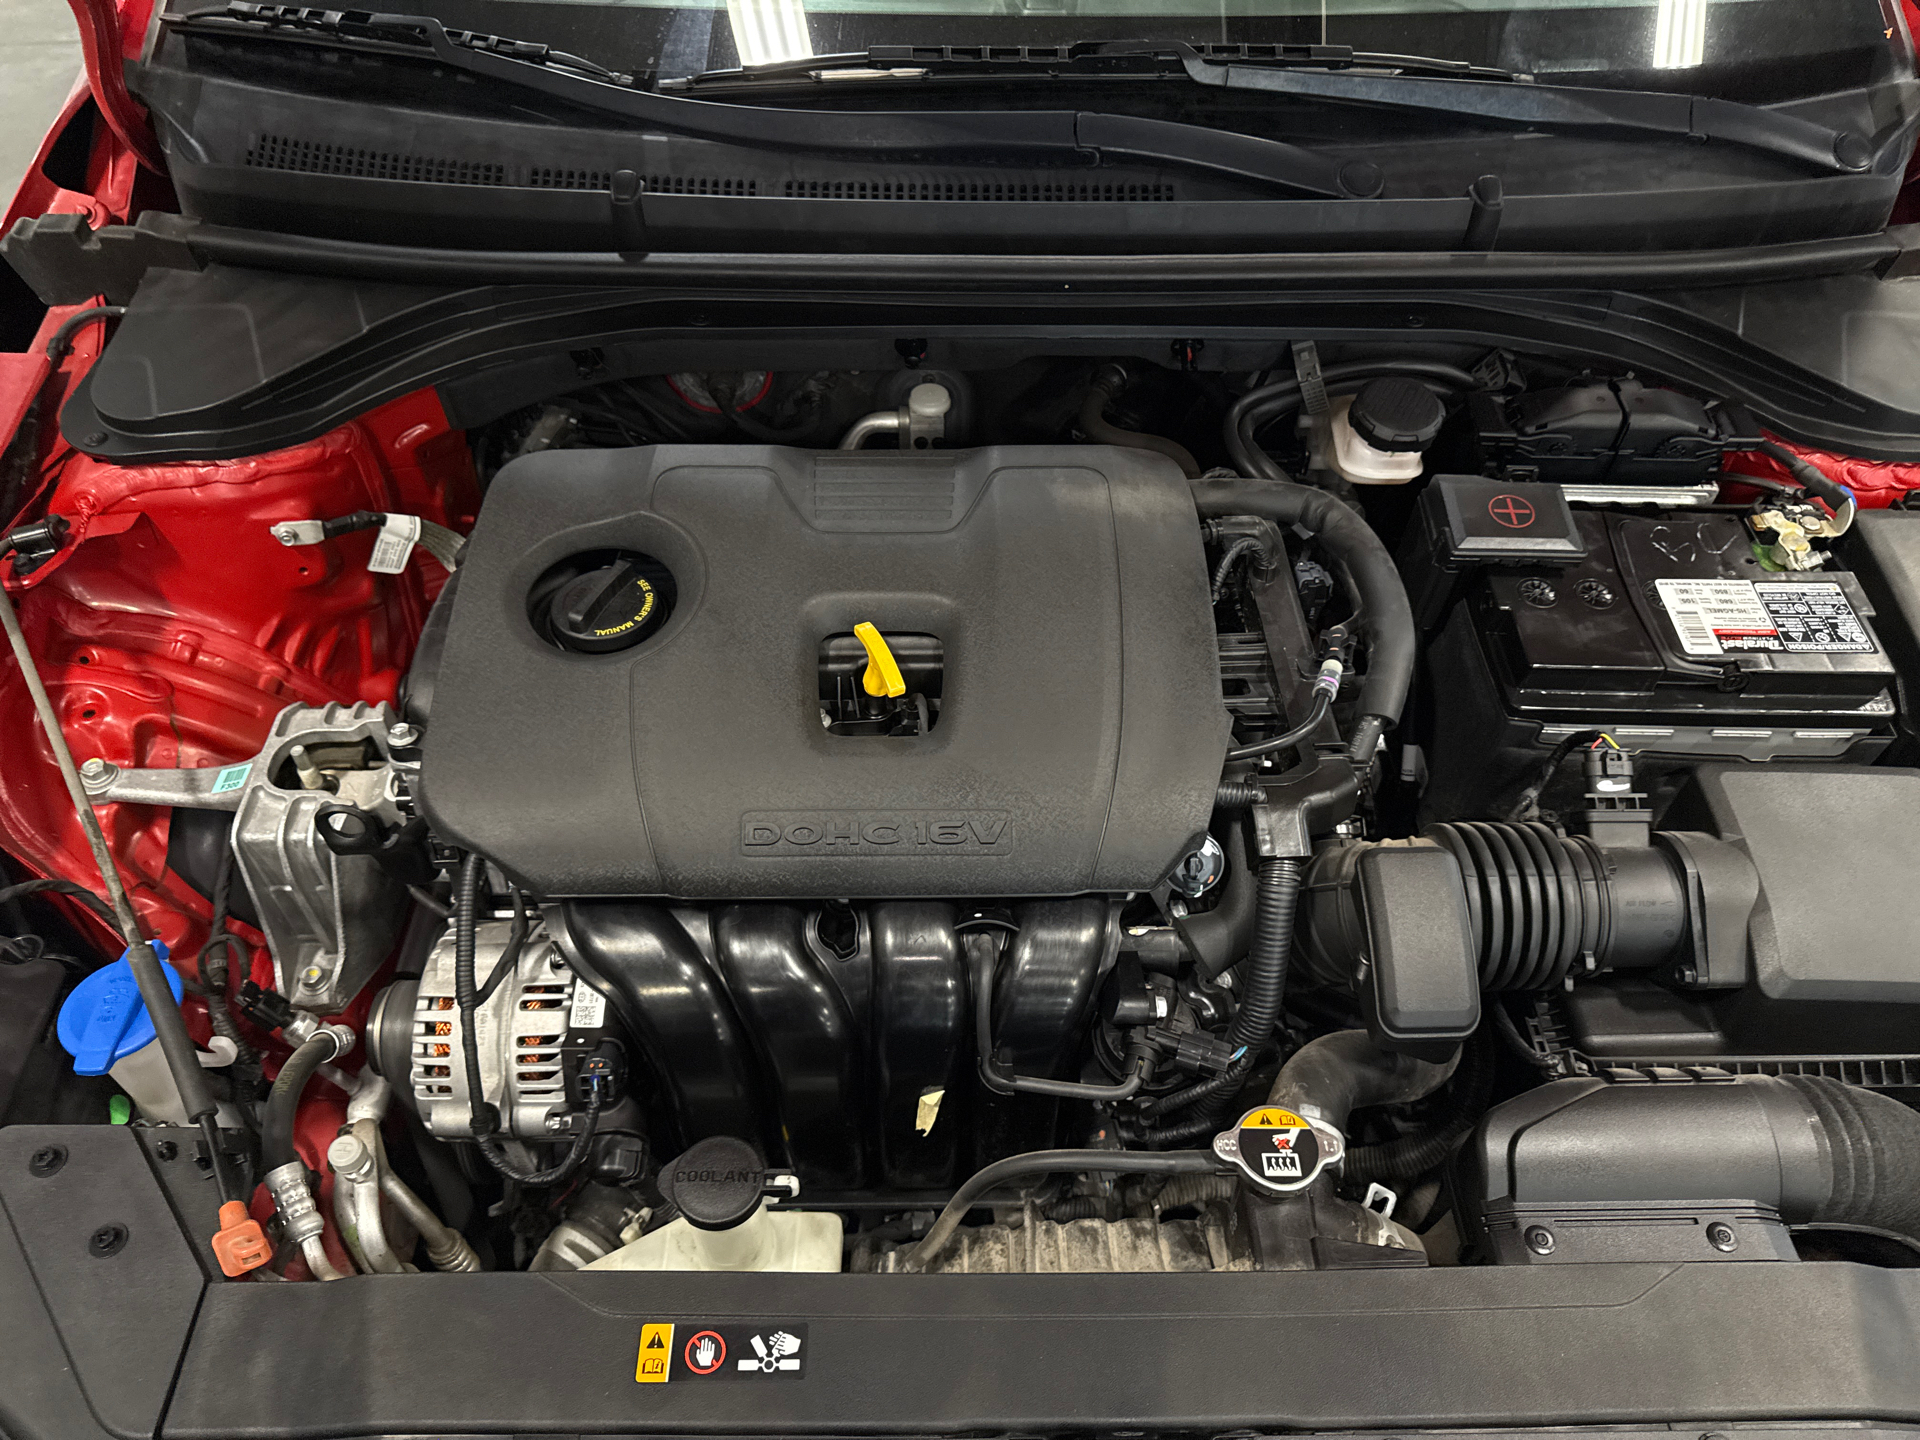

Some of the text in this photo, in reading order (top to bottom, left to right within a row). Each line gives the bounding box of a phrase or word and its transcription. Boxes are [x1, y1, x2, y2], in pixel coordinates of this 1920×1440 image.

[594, 579, 654, 636] SEE OWNER'S MANUAL
[1720, 639, 1784, 650] Duralast
[745, 819, 1008, 846] DOHC 16V
[1216, 1139, 1339, 1152] HCC 1.1
[675, 1169, 762, 1184] COOLANT
